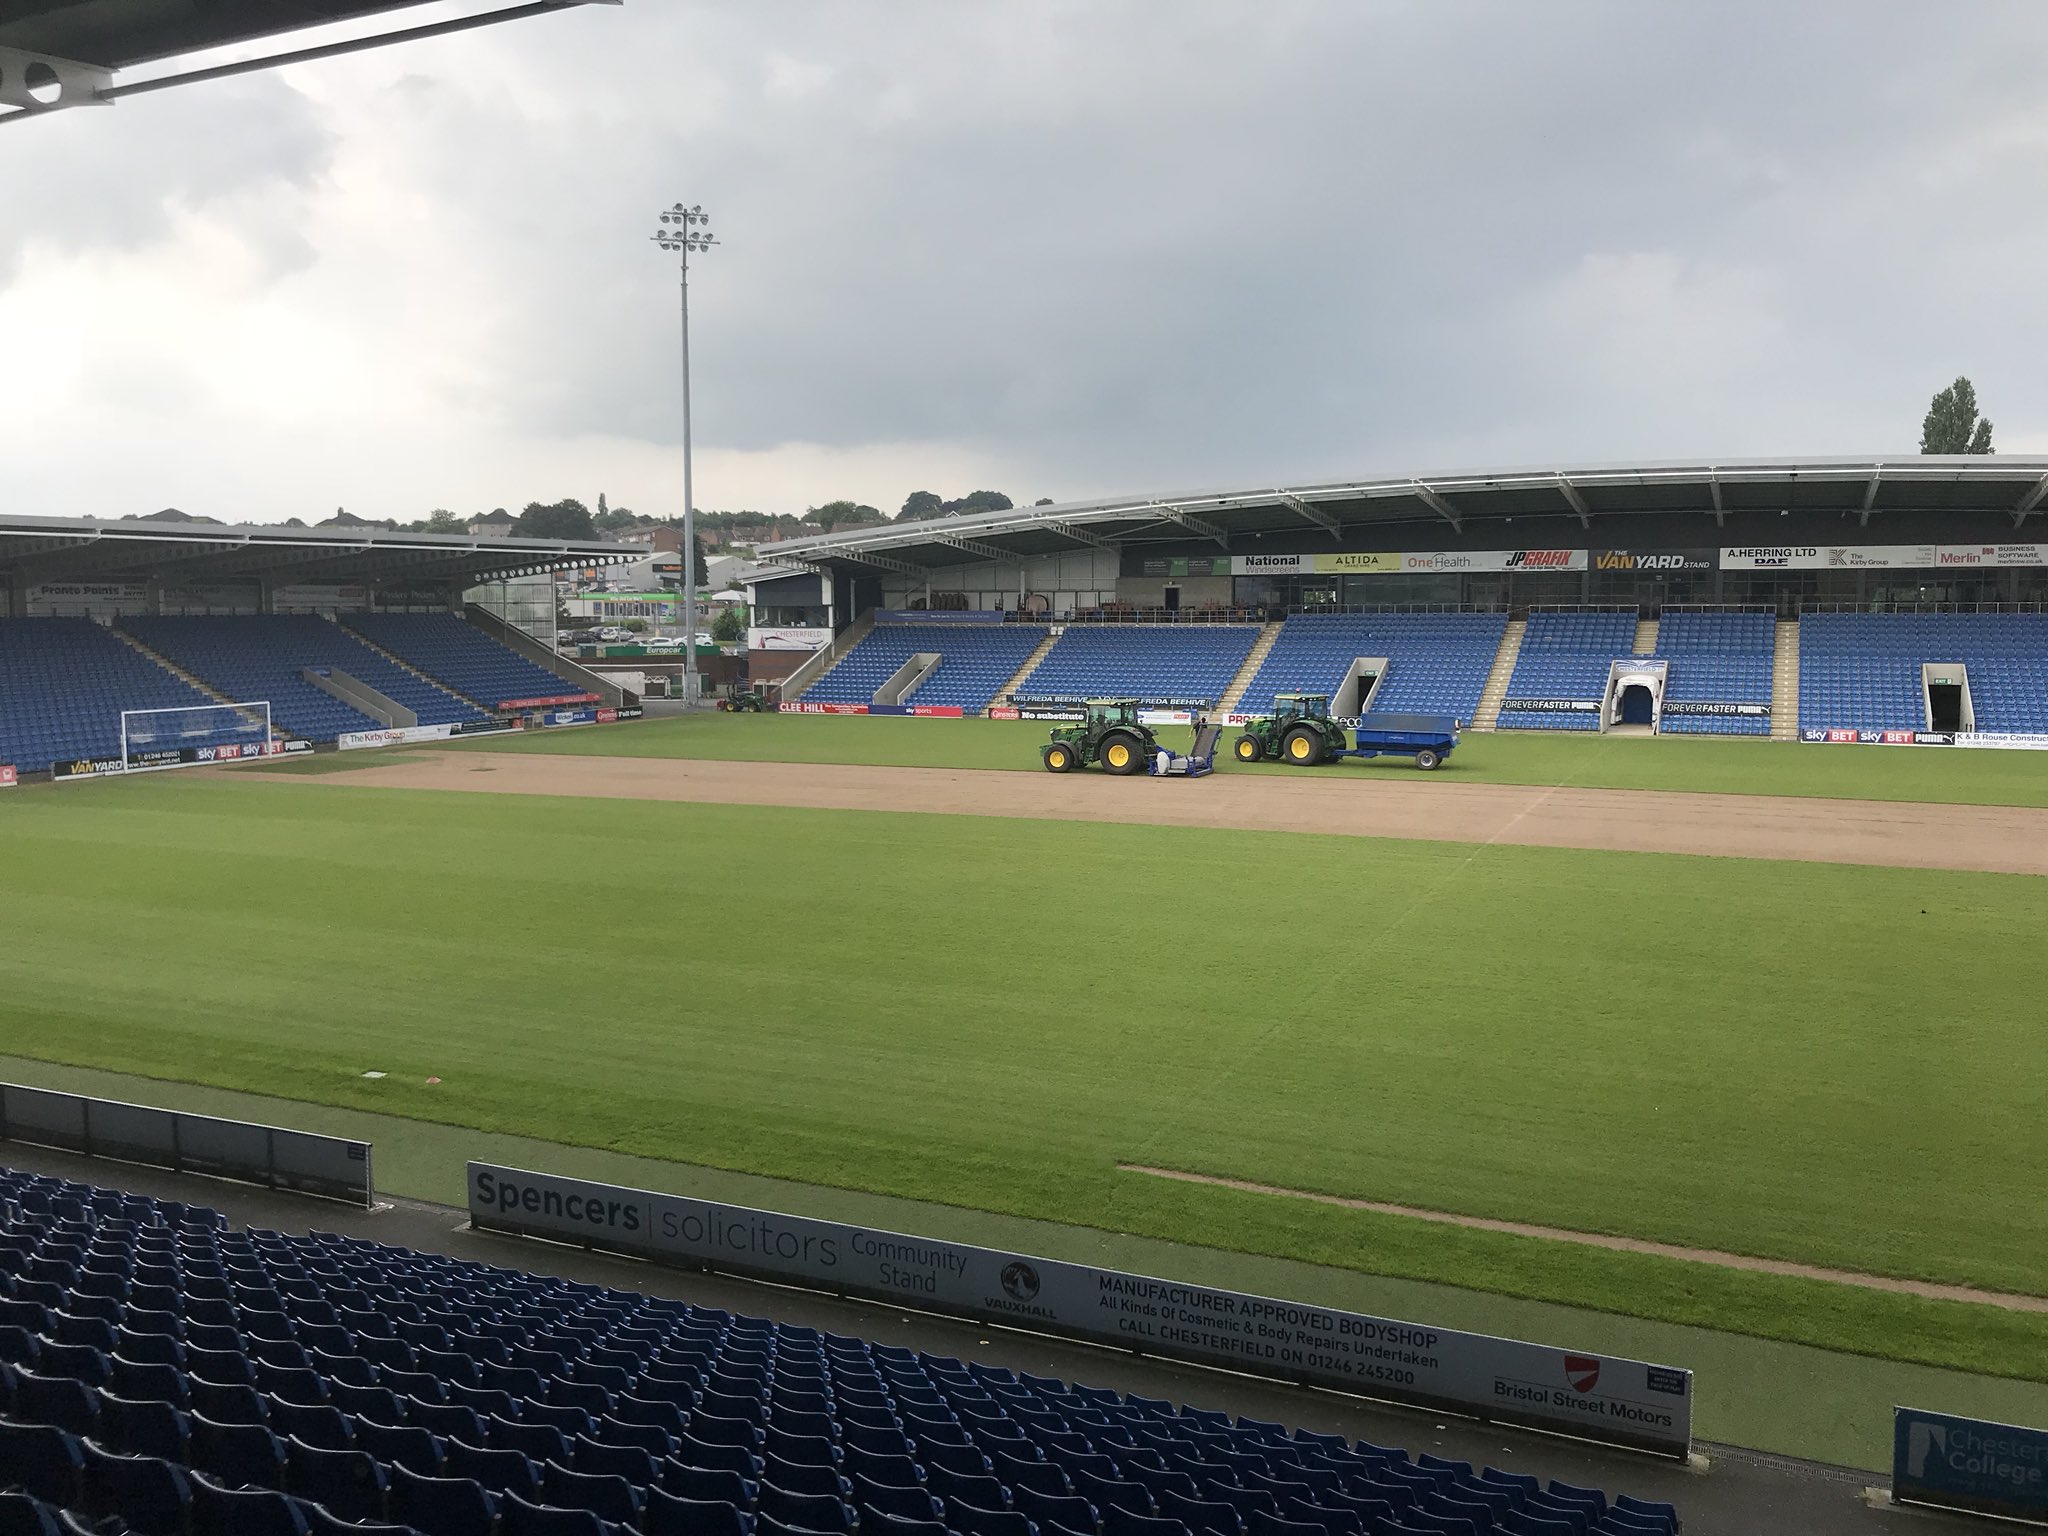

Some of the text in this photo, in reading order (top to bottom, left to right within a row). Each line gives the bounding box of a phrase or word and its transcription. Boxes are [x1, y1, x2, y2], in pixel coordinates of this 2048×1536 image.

[1505, 551, 1572, 566] JPGRAFIX
[1596, 550, 1711, 569] VANYARD STAND
[1727, 548, 1817, 557] A.HERRING LTD
[1940, 553, 1981, 563] Merlin
[1245, 555, 1300, 566] National
[1336, 556, 1379, 564] ALTIDA
[1245, 565, 1300, 574] Windscreens
[41, 585, 81, 595] Pronto
[775, 630, 822, 638] CHESTERFIELD
[779, 703, 826, 713] CLEE HILL
[1169, 698, 1206, 706] BEEHIVE
[1036, 712, 1085, 720] substitute
[350, 734, 364, 743] The
[364, 732, 384, 743] Kirby
[1806, 730, 1910, 743] sky BET sky BET
[1915, 734, 1943, 743] PUMA
[198, 747, 217, 761] sky
[219, 747, 239, 758] BET
[243, 744, 260, 756] sky
[71, 760, 123, 774] VANYARD
[476, 1171, 837, 1266] Spencers solicitors
[851, 1232, 968, 1278] Community
[879, 1263, 936, 1292] Stand
[984, 1296, 1057, 1320] VAUXHALL
[1099, 1275, 1438, 1350] MANUFACTURER APPROVED BODYSHOP
[1099, 1295, 1439, 1369] All Kinds Of Cosmetic & Body Repairs Undertaken
[1118, 1317, 1415, 1385] CALL CHESTERFIELD ON 01246 245200
[1493, 1379, 1673, 1427] Bristol Street Motors
[1950, 1428, 2048, 1464] Chester
[1949, 1450, 2042, 1486] College
